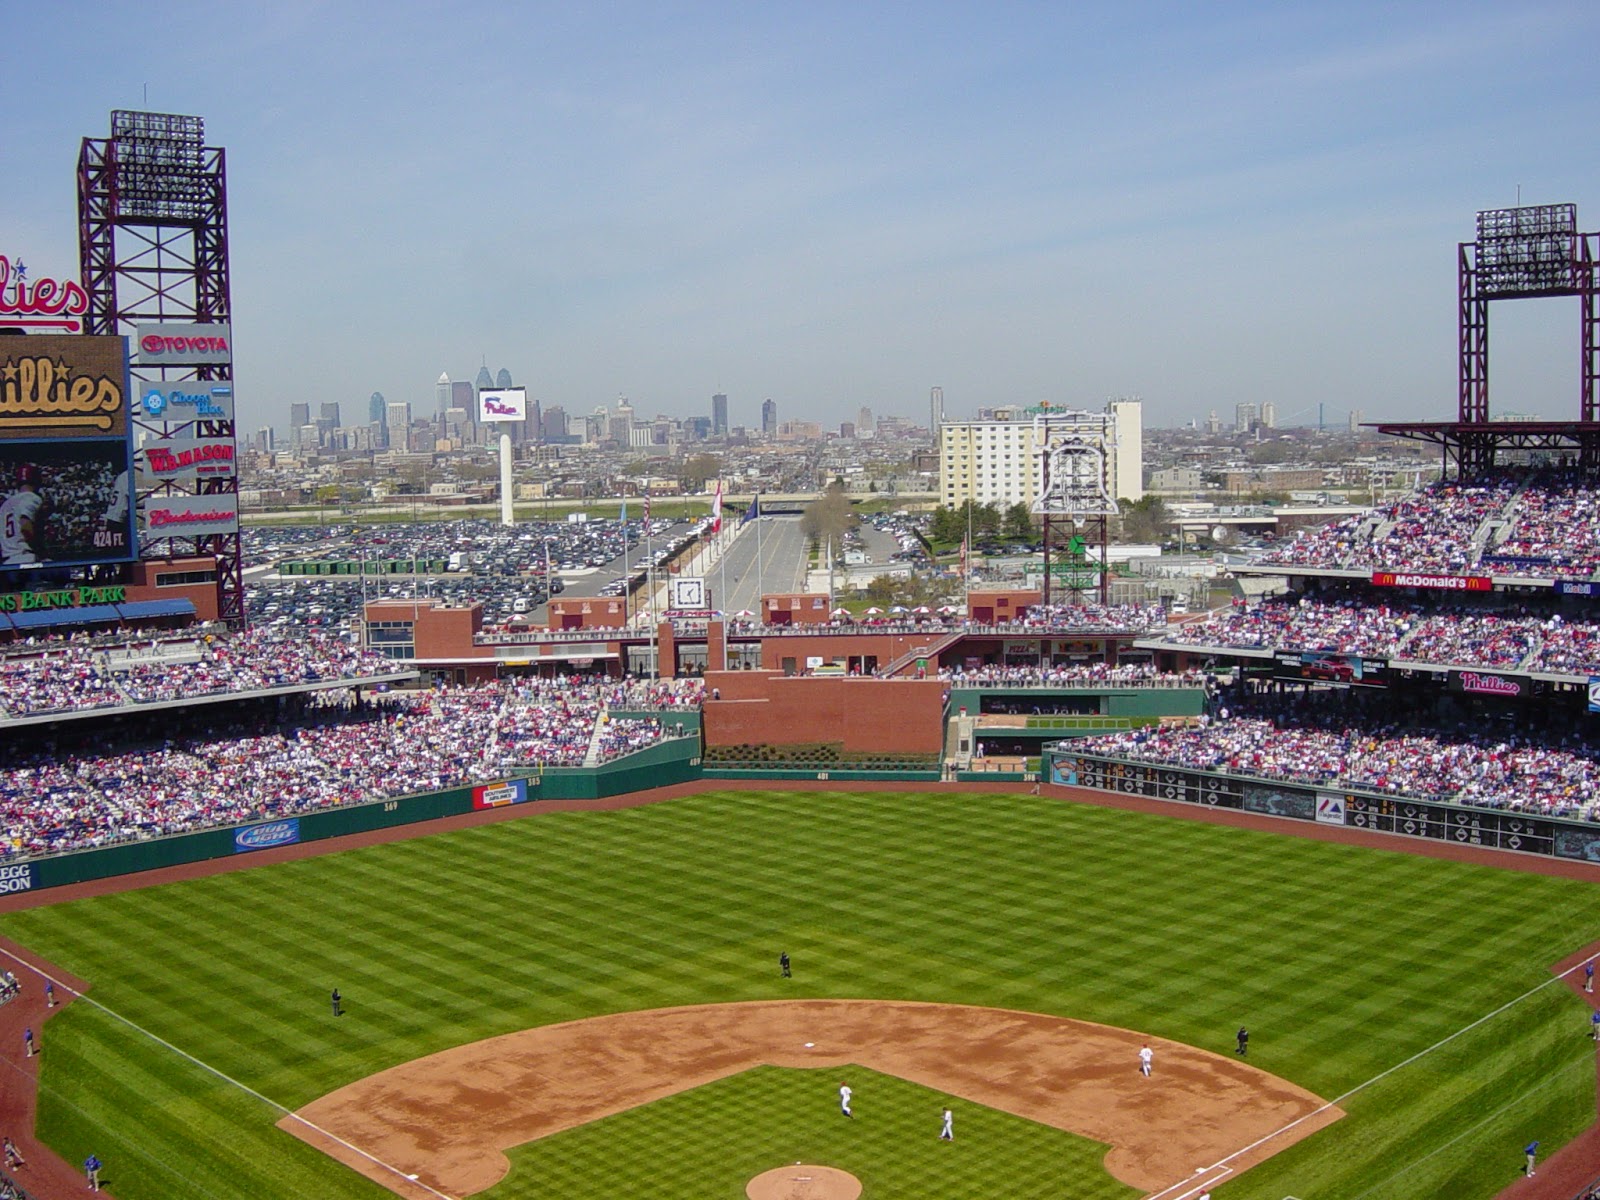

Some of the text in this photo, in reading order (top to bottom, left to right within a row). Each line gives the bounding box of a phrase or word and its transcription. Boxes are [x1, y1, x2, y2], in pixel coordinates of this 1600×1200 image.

[164, 336, 229, 351] TOYOTA
[149, 508, 235, 526] Budweiser
[93, 532, 112, 547] 424
[1395, 575, 1467, 588] McDonald's
[1563, 583, 1591, 594] Mobil
[21, 590, 74, 610] BANK
[79, 586, 126, 605] PARK
[1459, 671, 1520, 692] Phillies
[253, 823, 289, 836] BUD
